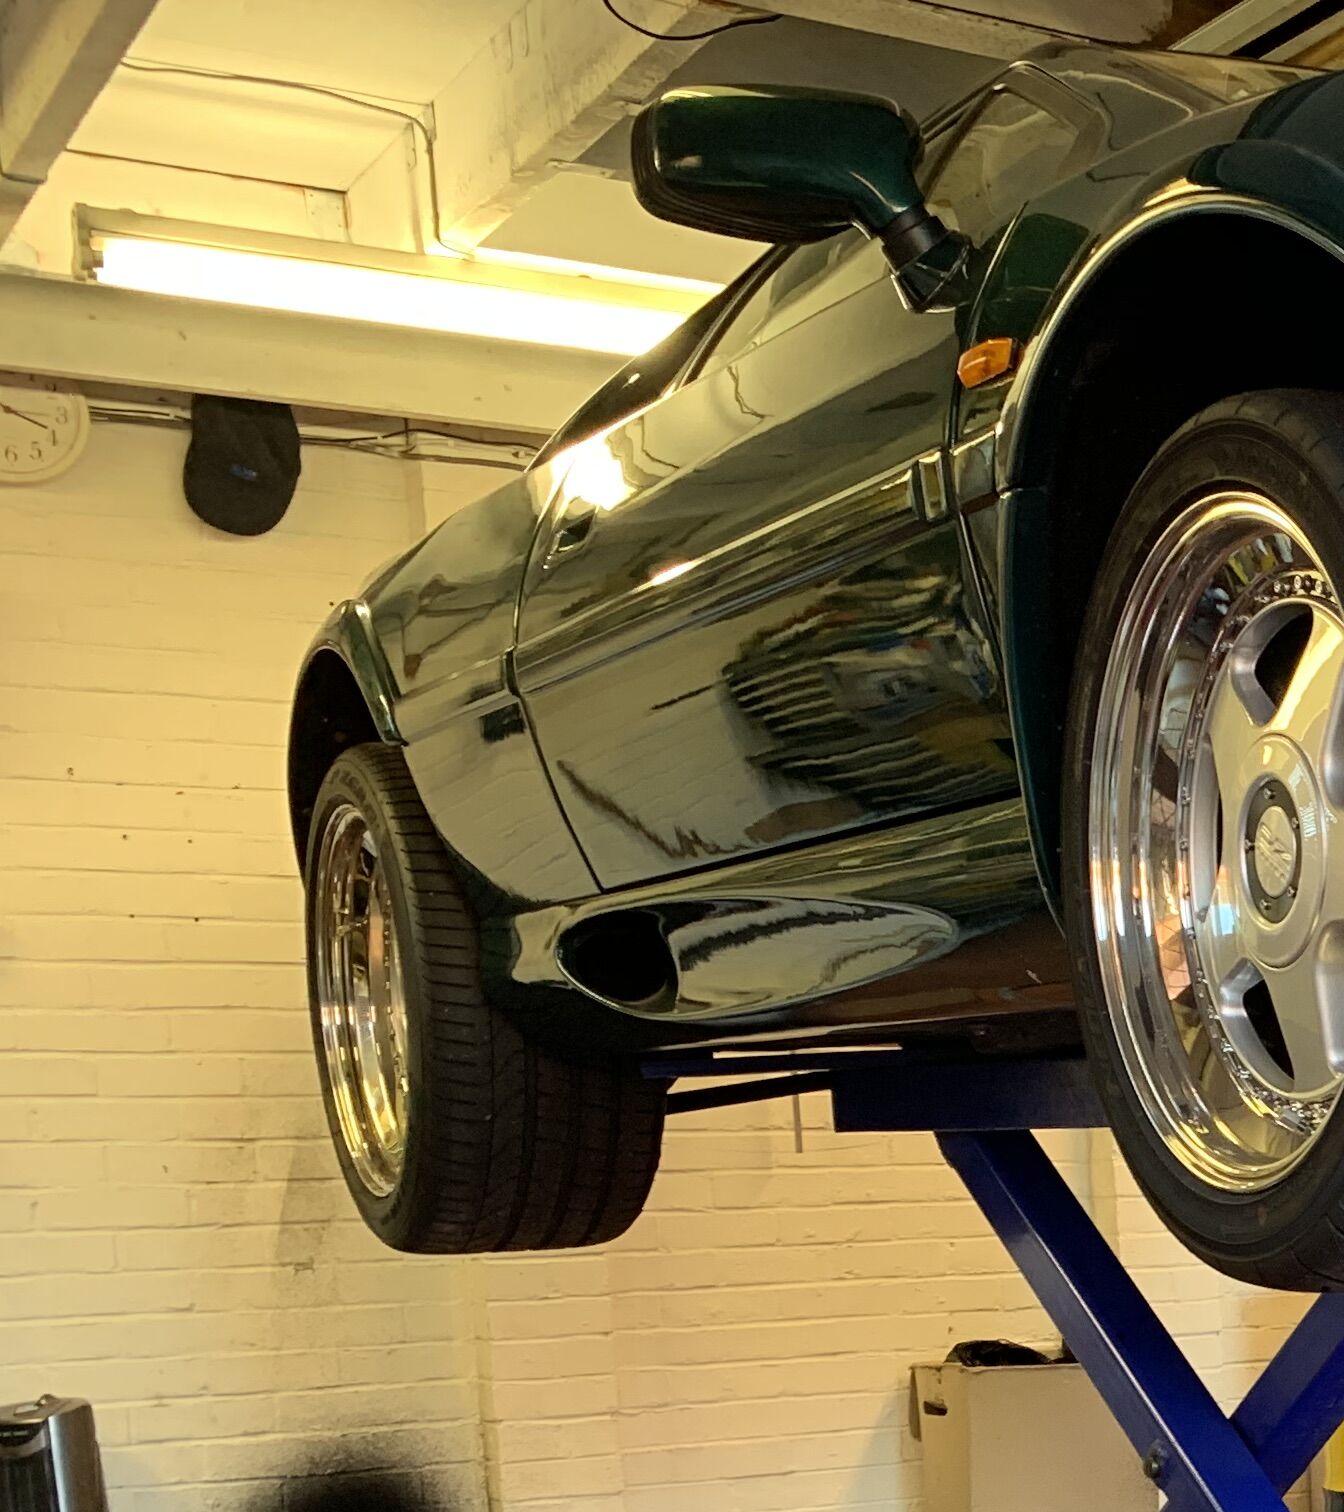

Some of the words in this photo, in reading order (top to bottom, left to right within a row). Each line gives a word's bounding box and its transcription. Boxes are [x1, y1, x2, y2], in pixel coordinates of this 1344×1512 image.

[56, 406, 68, 425] 3
[4, 445, 18, 467] 6
[29, 441, 43, 461] 5
